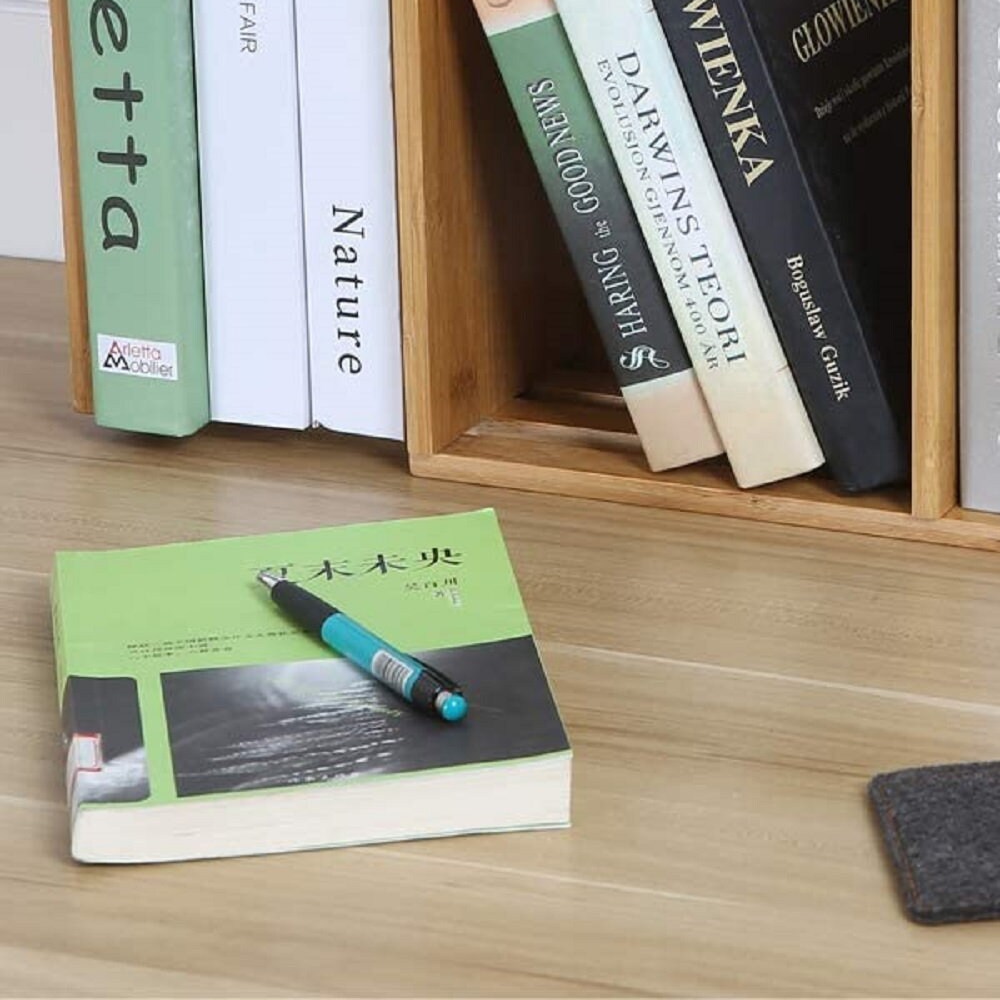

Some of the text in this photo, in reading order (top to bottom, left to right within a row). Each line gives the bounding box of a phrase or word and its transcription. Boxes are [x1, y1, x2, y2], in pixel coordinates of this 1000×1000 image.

[239, 2, 258, 54] FAIR
[526, 78, 575, 148] NEWS
[556, 149, 599, 214] GOOD
[596, 58, 651, 181] EVOLUSJON
[644, 187, 690, 290] GJENNOM
[685, 298, 707, 335] 400
[616, 50, 748, 365] DARWINS TEORI
[594, 219, 613, 239] the
[332, 204, 365, 375] Nature
[103, 353, 173, 377] Mobilier
[108, 340, 161, 361] Arletta
[820, 345, 850, 402] Guzik
